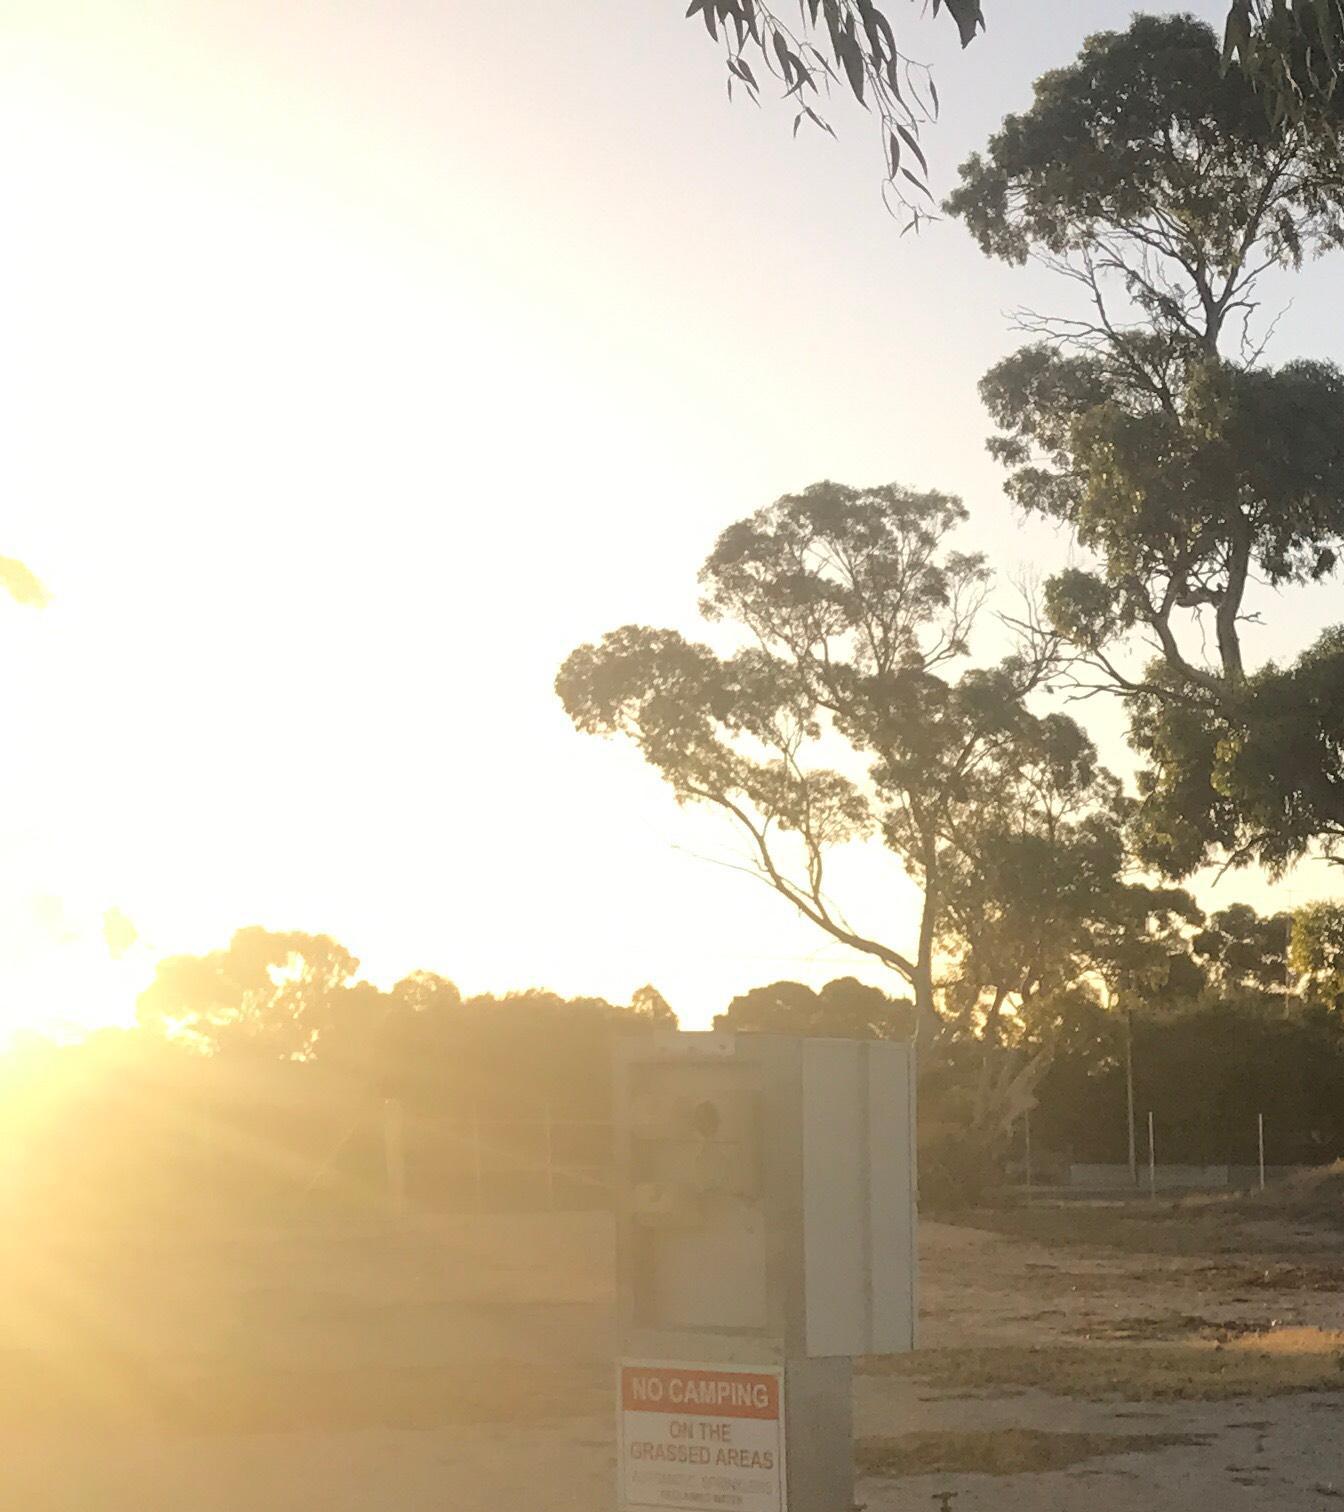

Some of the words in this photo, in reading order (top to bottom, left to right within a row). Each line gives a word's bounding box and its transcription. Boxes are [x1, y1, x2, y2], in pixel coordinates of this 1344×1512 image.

[632, 1376, 663, 1402] NO
[668, 1378, 769, 1408] CAMPING
[669, 1420, 693, 1440] ON
[699, 1422, 732, 1442] THE
[630, 1441, 711, 1466] GRASSED
[715, 1447, 773, 1470] AREAS
